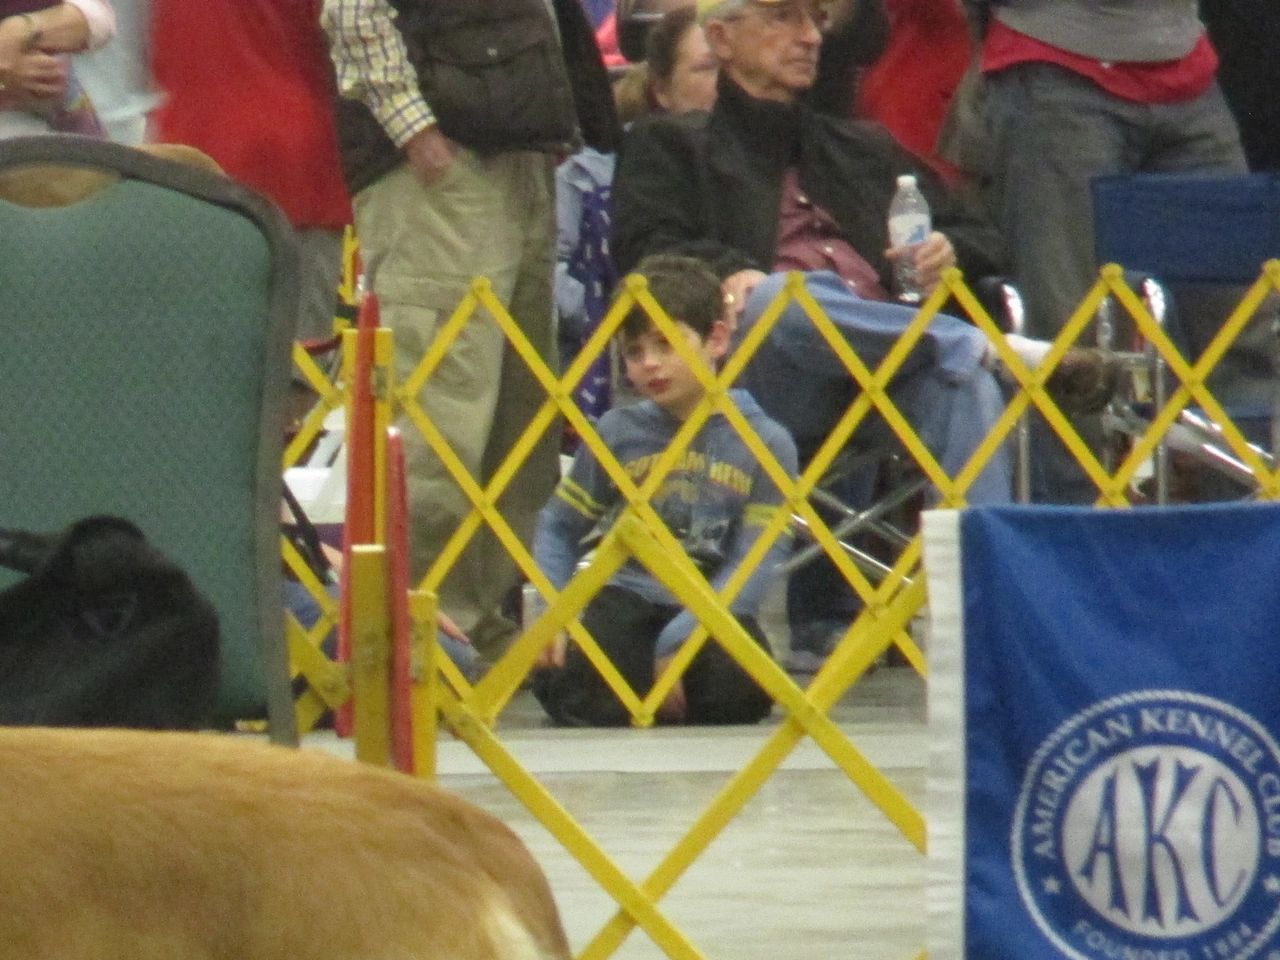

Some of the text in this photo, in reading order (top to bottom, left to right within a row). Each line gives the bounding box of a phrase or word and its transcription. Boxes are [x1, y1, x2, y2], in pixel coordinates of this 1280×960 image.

[1033, 713, 1133, 860] AMERICAN
[1139, 707, 1264, 776] KENNEL
[1078, 755, 1248, 930] AKC
